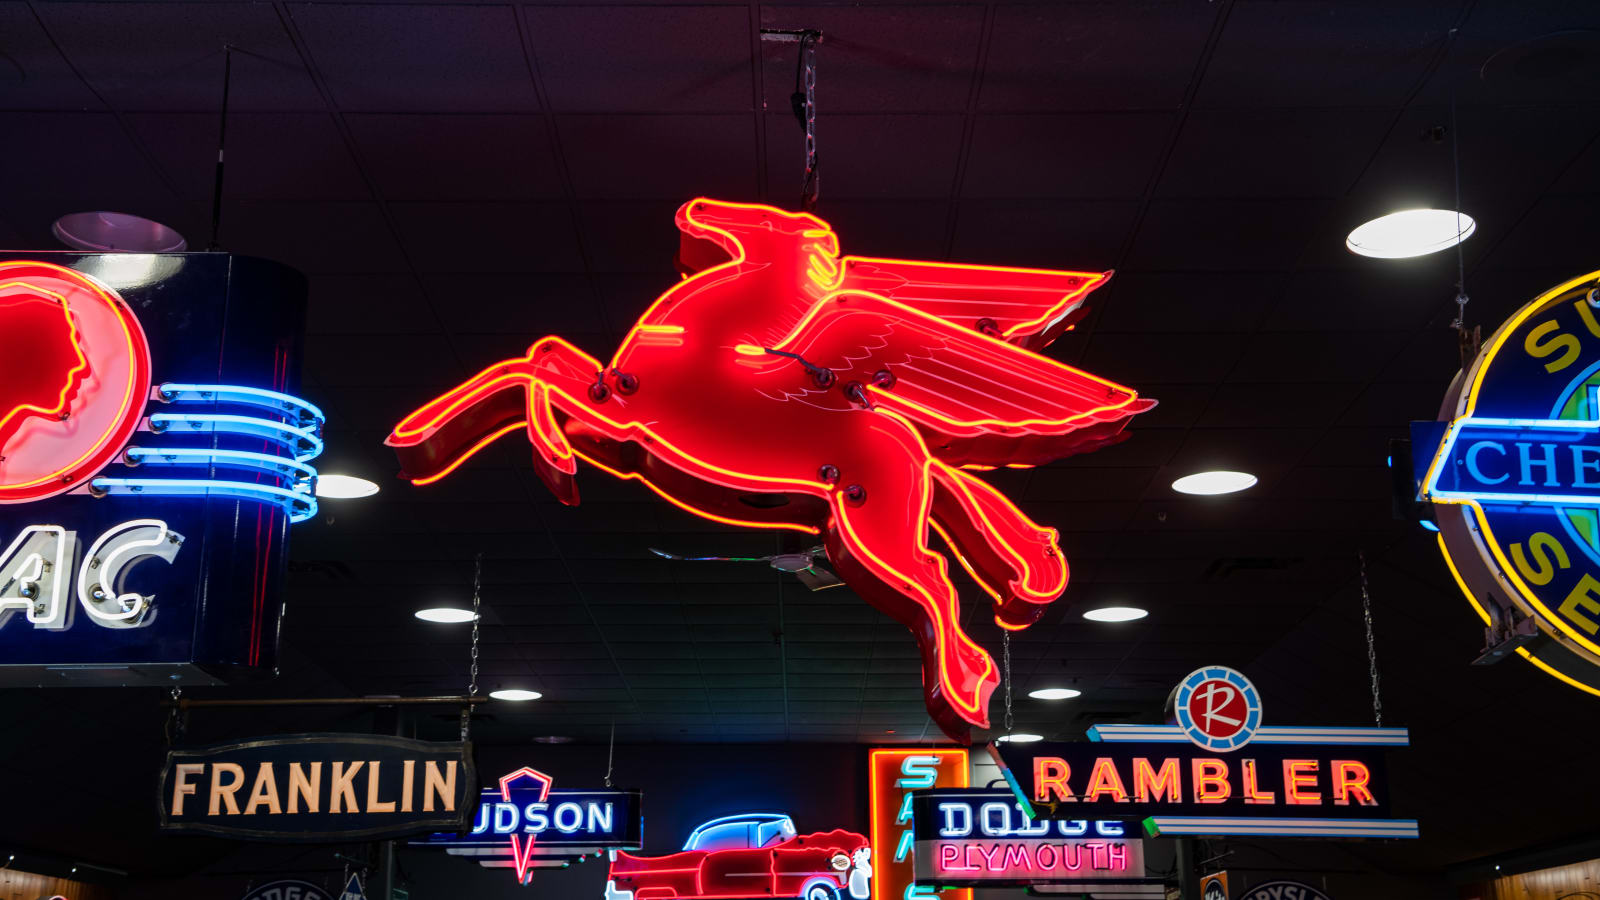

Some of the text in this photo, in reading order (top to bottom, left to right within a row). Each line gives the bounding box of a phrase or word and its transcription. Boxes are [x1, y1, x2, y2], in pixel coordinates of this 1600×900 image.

[1465, 440, 1600, 488] CHE
[1196, 683, 1242, 732] R
[172, 760, 458, 816] FRANKLIN
[1033, 756, 1379, 806] RAMBLER
[471, 802, 614, 834] UDSON
[940, 843, 1127, 872] PLYMOUTH
